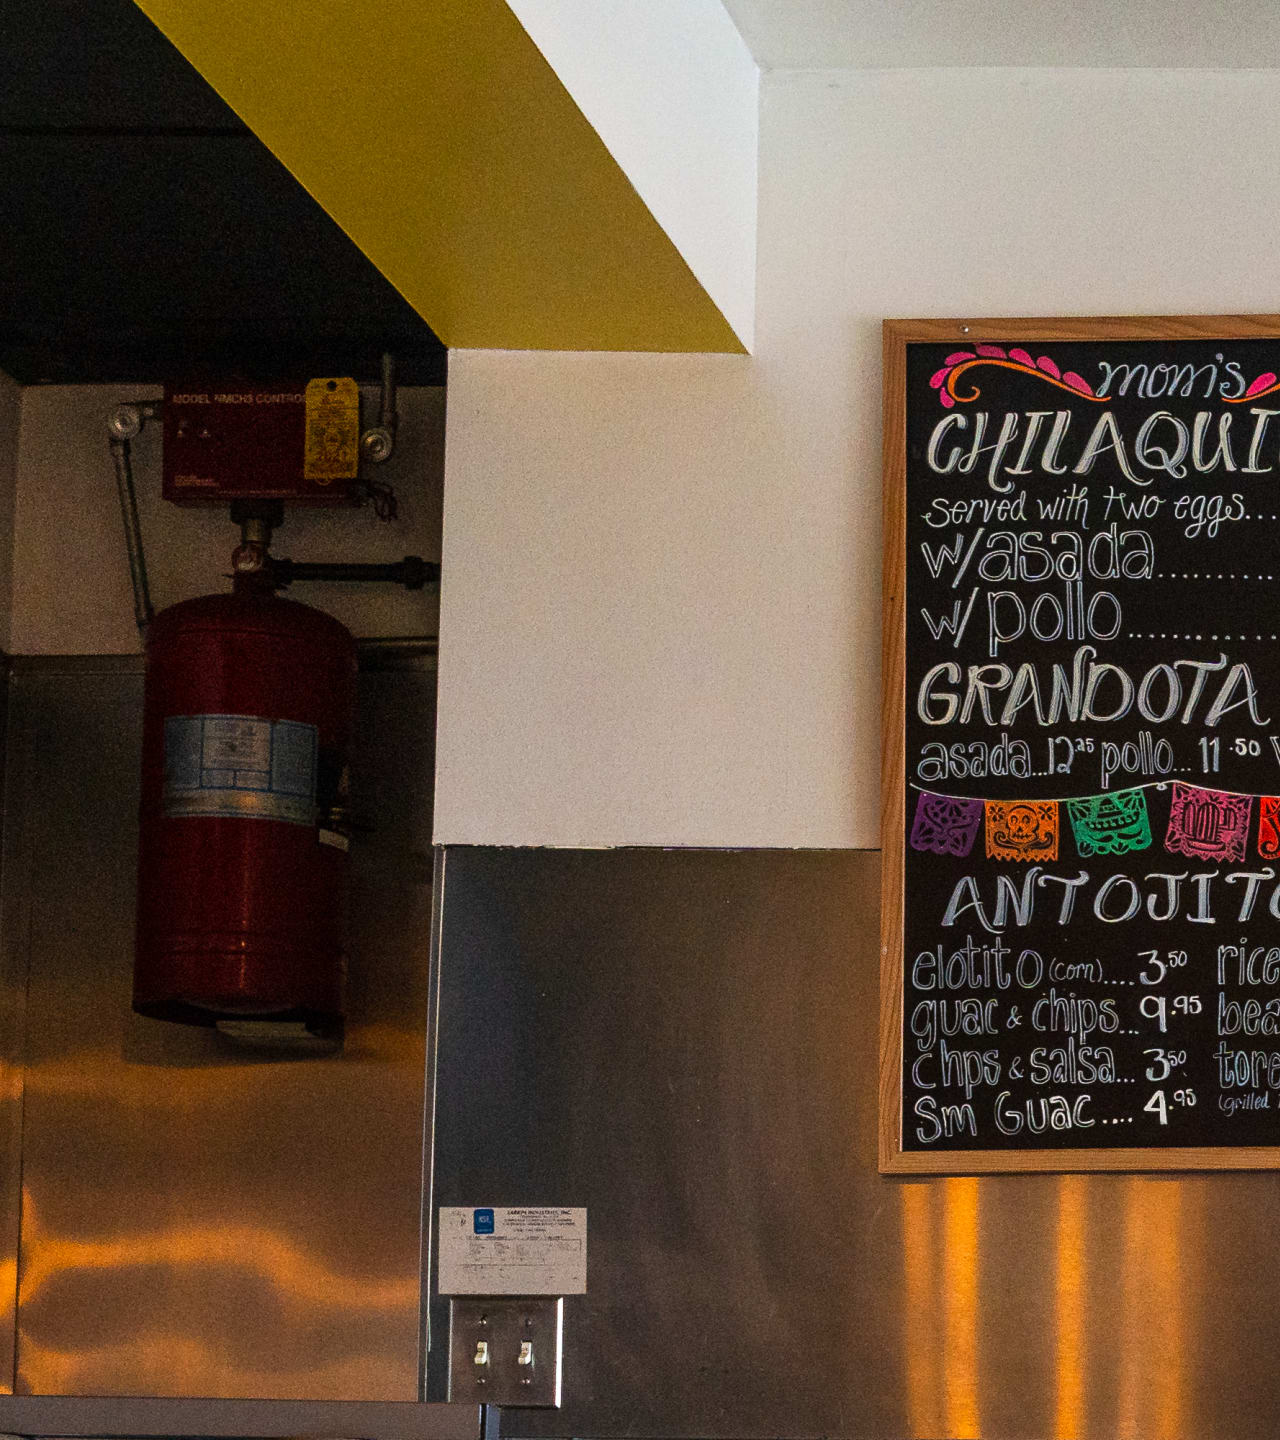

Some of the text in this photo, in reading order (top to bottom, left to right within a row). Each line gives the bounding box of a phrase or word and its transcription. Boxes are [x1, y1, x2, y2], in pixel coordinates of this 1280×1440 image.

[1098, 353, 1246, 398] mom's
[922, 488, 1026, 527] served
[1039, 484, 1089, 528] with
[1103, 486, 1165, 519] two
[1174, 493, 1246, 538] eggs
[918, 646, 1269, 727] GRANDOTA
[918, 733, 1031, 781] asada
[1102, 731, 1174, 789] pollo
[913, 935, 1043, 990] elotito
[1218, 937, 1280, 985] rice
[911, 999, 998, 1051] guac
[1007, 1006, 1022, 1028] &
[1032, 988, 1119, 1045] chips
[1009, 1057, 1024, 1079] &
[1031, 1037, 1116, 1083] salsa
[915, 1096, 977, 1142] Sm
[995, 1091, 1095, 1135] Guac
